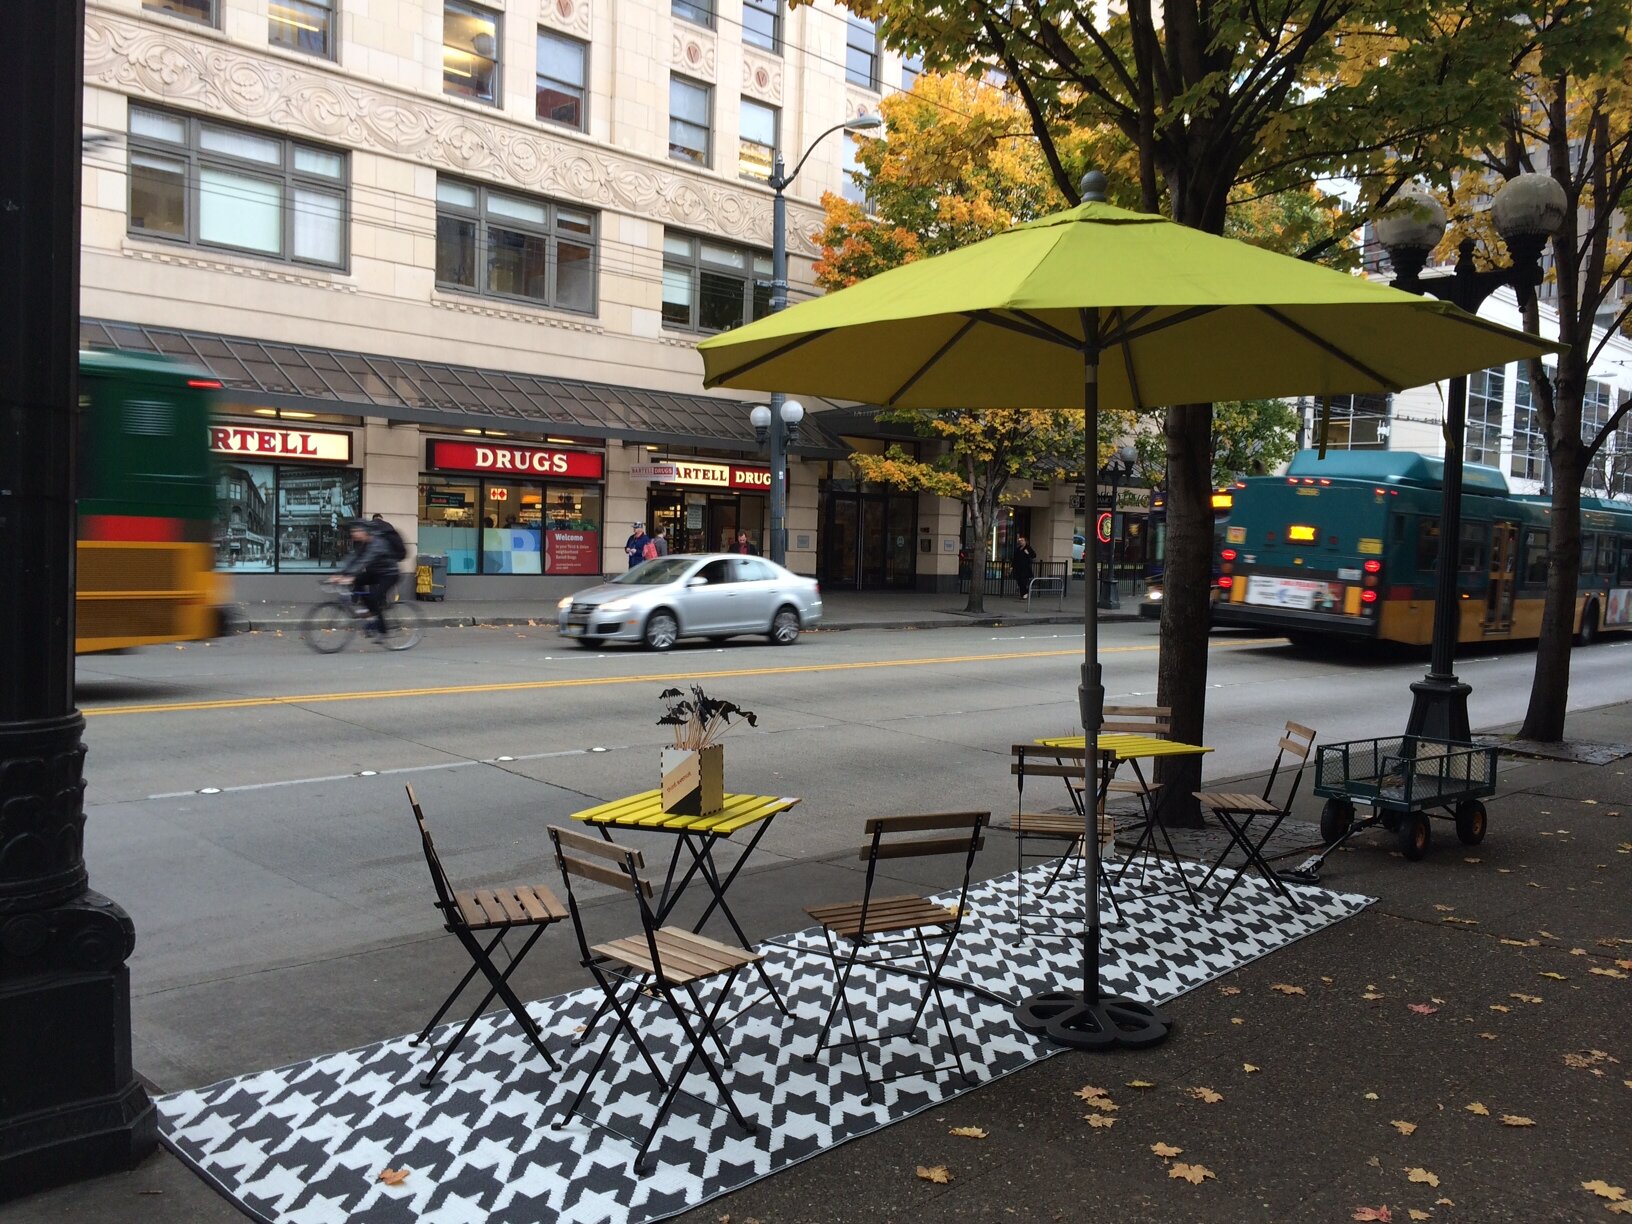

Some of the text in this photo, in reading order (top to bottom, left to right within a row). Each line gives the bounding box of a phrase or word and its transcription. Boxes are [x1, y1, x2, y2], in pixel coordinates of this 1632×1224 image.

[211, 428, 318, 456] RTELL
[475, 447, 568, 473] DRUGS
[675, 466, 771, 486] ARTELL DRUG
[555, 533, 584, 541] Welcome
